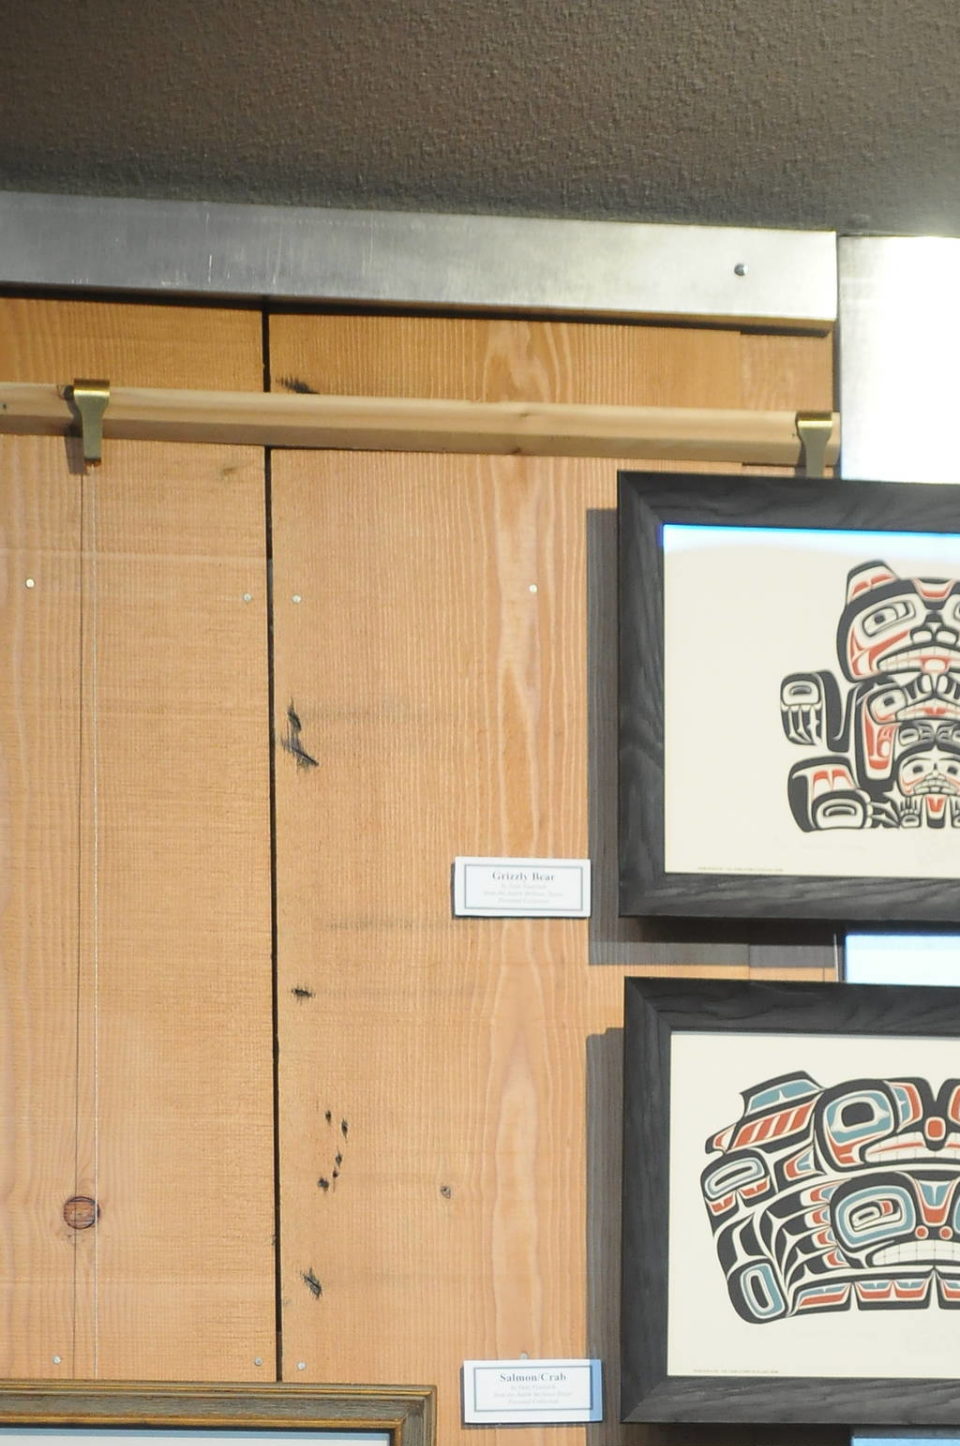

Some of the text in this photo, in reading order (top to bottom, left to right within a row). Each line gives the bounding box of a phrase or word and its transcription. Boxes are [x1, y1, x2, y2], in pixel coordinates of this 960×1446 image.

[492, 871, 555, 882] Grizzly Bear
[500, 1373, 567, 1382] Salmon Crab
